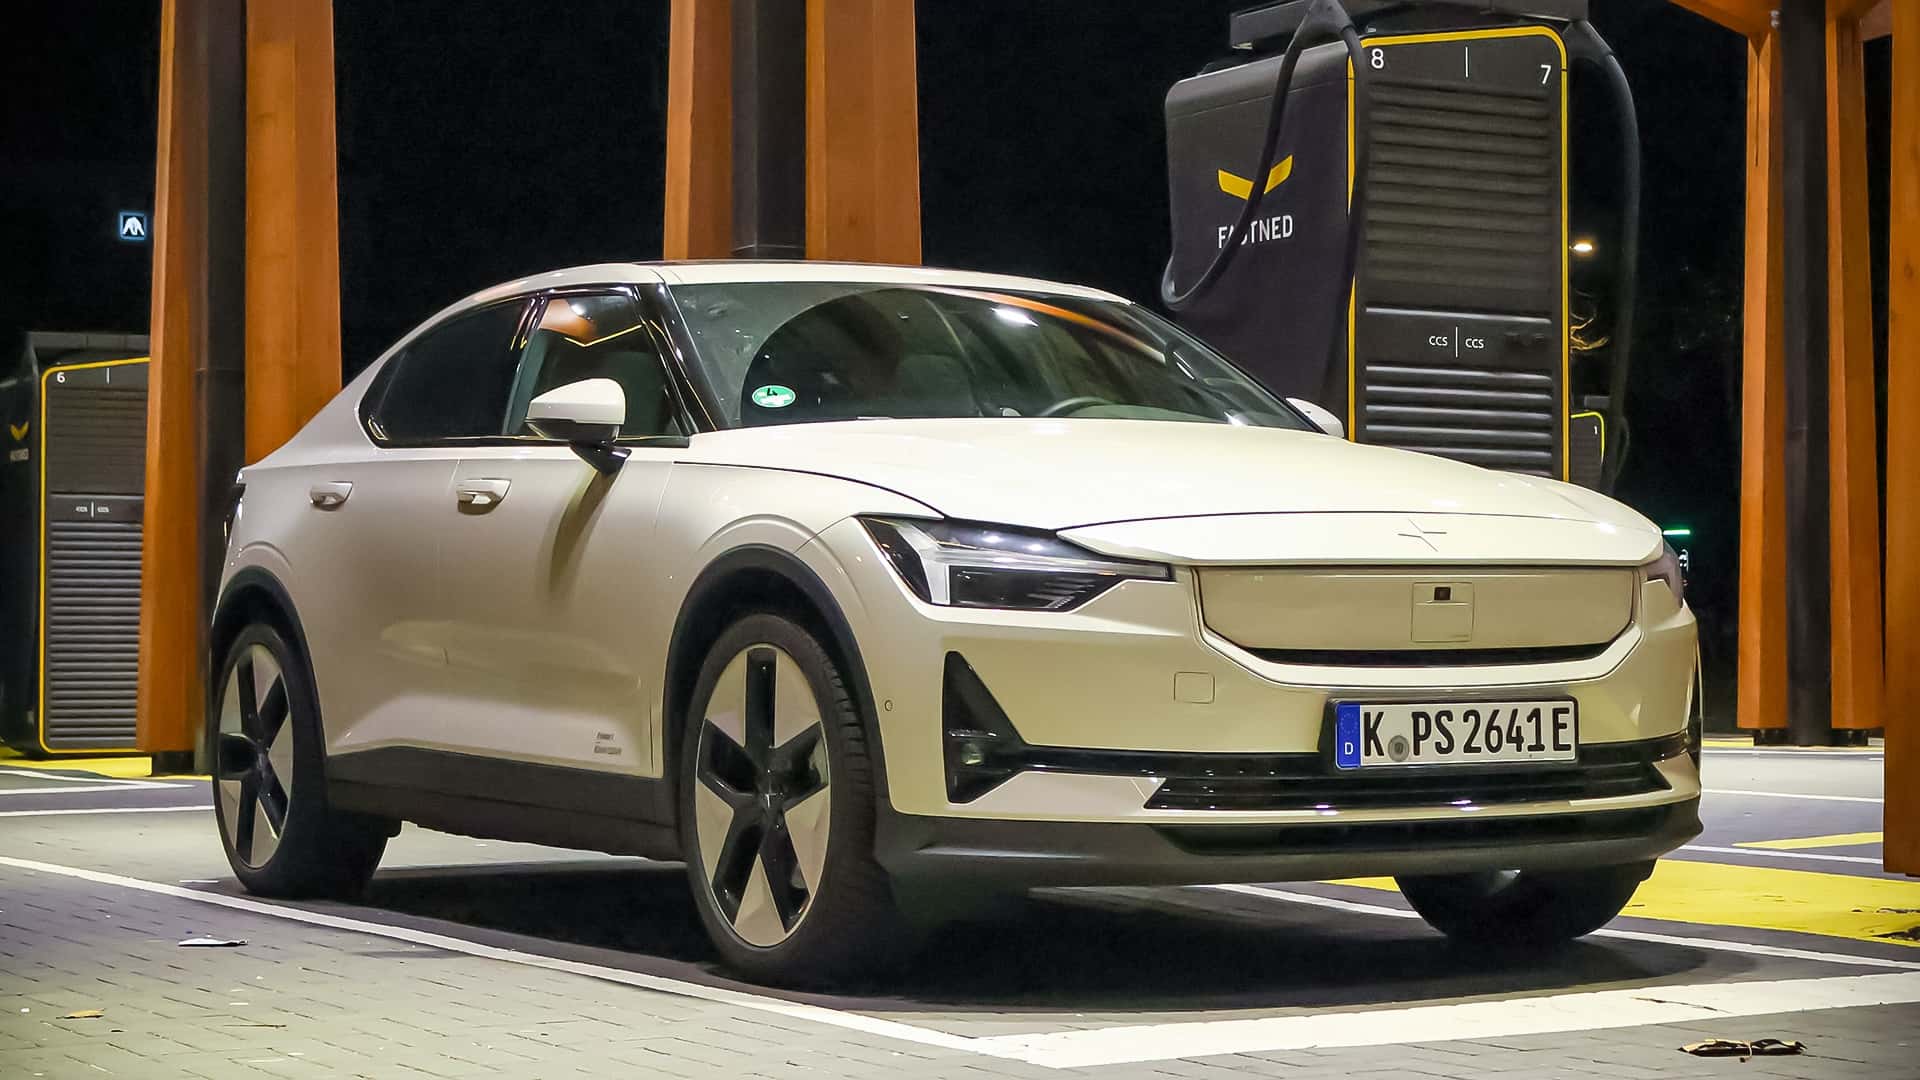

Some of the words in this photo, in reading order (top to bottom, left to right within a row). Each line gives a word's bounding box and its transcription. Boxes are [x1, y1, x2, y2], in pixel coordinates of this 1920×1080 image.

[1371, 48, 1384, 69] 8
[1540, 64, 1551, 84] 7
[1428, 335, 1448, 346] CCS
[1465, 338, 1485, 349] CCS
[56, 371, 66, 384] 6
[1363, 711, 1385, 756] K
[1344, 742, 1354, 755] D
